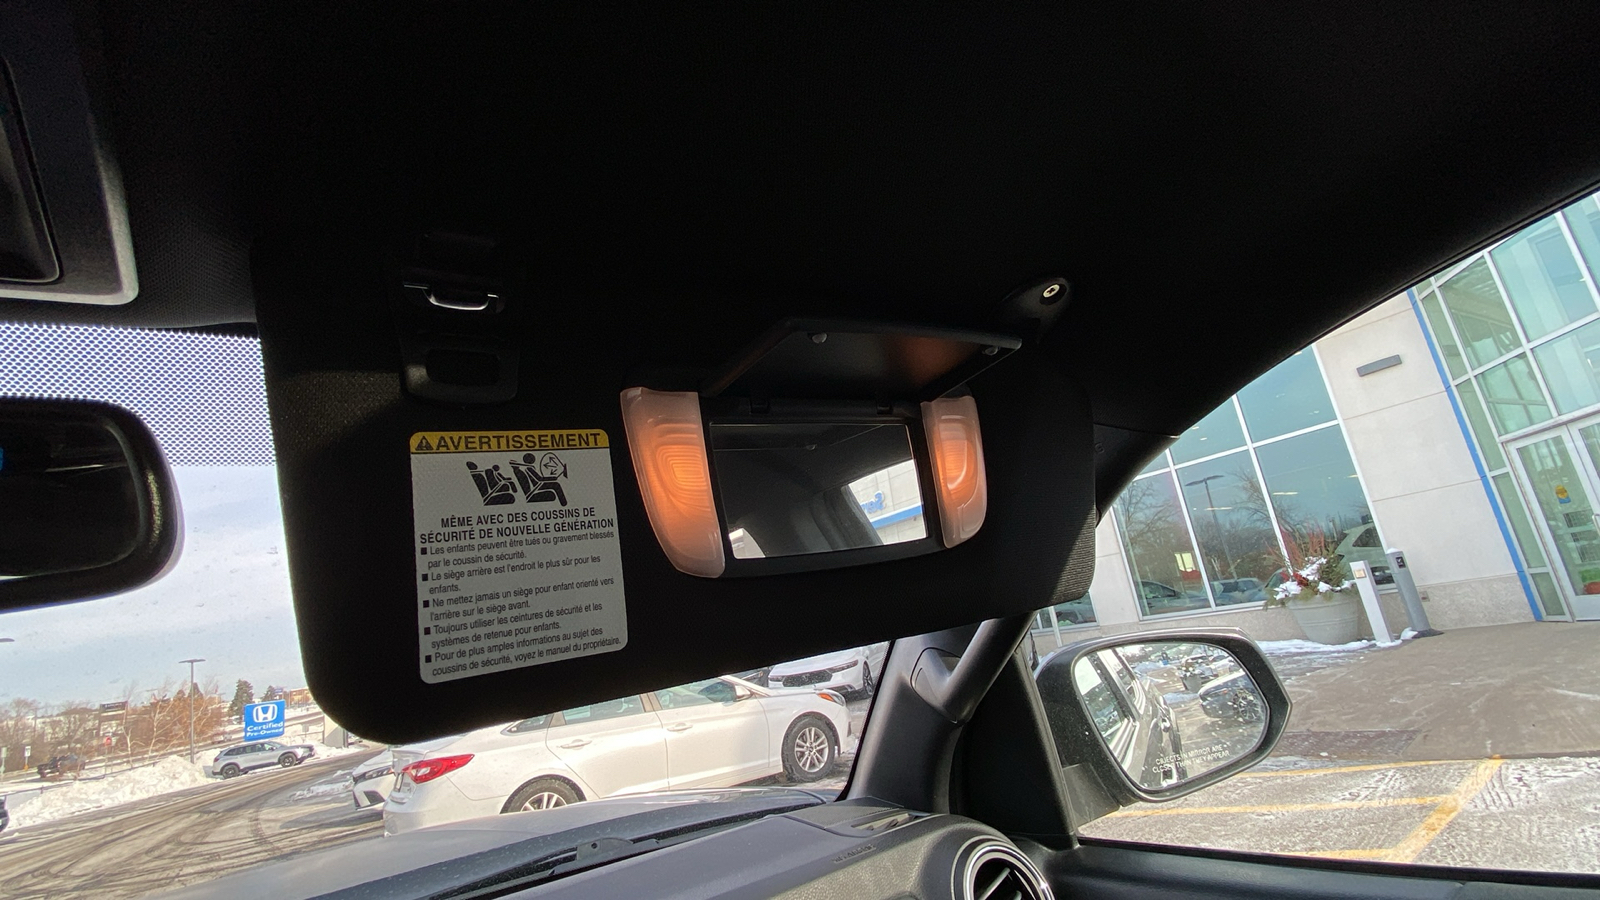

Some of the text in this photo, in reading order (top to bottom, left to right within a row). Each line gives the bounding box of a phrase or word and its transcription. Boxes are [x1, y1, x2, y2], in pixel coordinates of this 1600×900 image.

[436, 433, 600, 450] AVERTISSEMENT
[441, 507, 595, 528] MÊME AVEC DES COUSSINS DE
[420, 518, 614, 544] SÉCURITÉ DE NOUVELLE GÉNÉRATION
[430, 546, 444, 555] Les
[446, 543, 475, 554] enfants
[478, 540, 507, 552] peuvent
[509, 538, 524, 548] être
[525, 536, 540, 546] tués
[553, 532, 588, 546] gravement
[590, 530, 614, 540] blessés
[428, 550, 526, 570] par le coussin de sécurité.
[431, 555, 600, 581] Le siège arrière est l'endroit le plus sûr pour les
[429, 584, 461, 594] enfants.
[432, 577, 614, 608] Ne mettez jamais un siège pour enfant orienté vers
[430, 600, 530, 621] l'arrière sur le siège avant.
[433, 602, 602, 634] Toujours utiliser les ceintures de sécurité et les
[432, 621, 561, 650] systèmes de retenue pour enfants.
[435, 627, 603, 662] Pour de plus amples informations au sujet des
[432, 636, 620, 676] coussins de sécurité, voyez le manuel du propriétaire.
[246, 727, 284, 737] Pre-Owned
[247, 721, 284, 732] Certified
[1207, 750, 1230, 760] APPEAR
[1212, 744, 1223, 752] ARE
